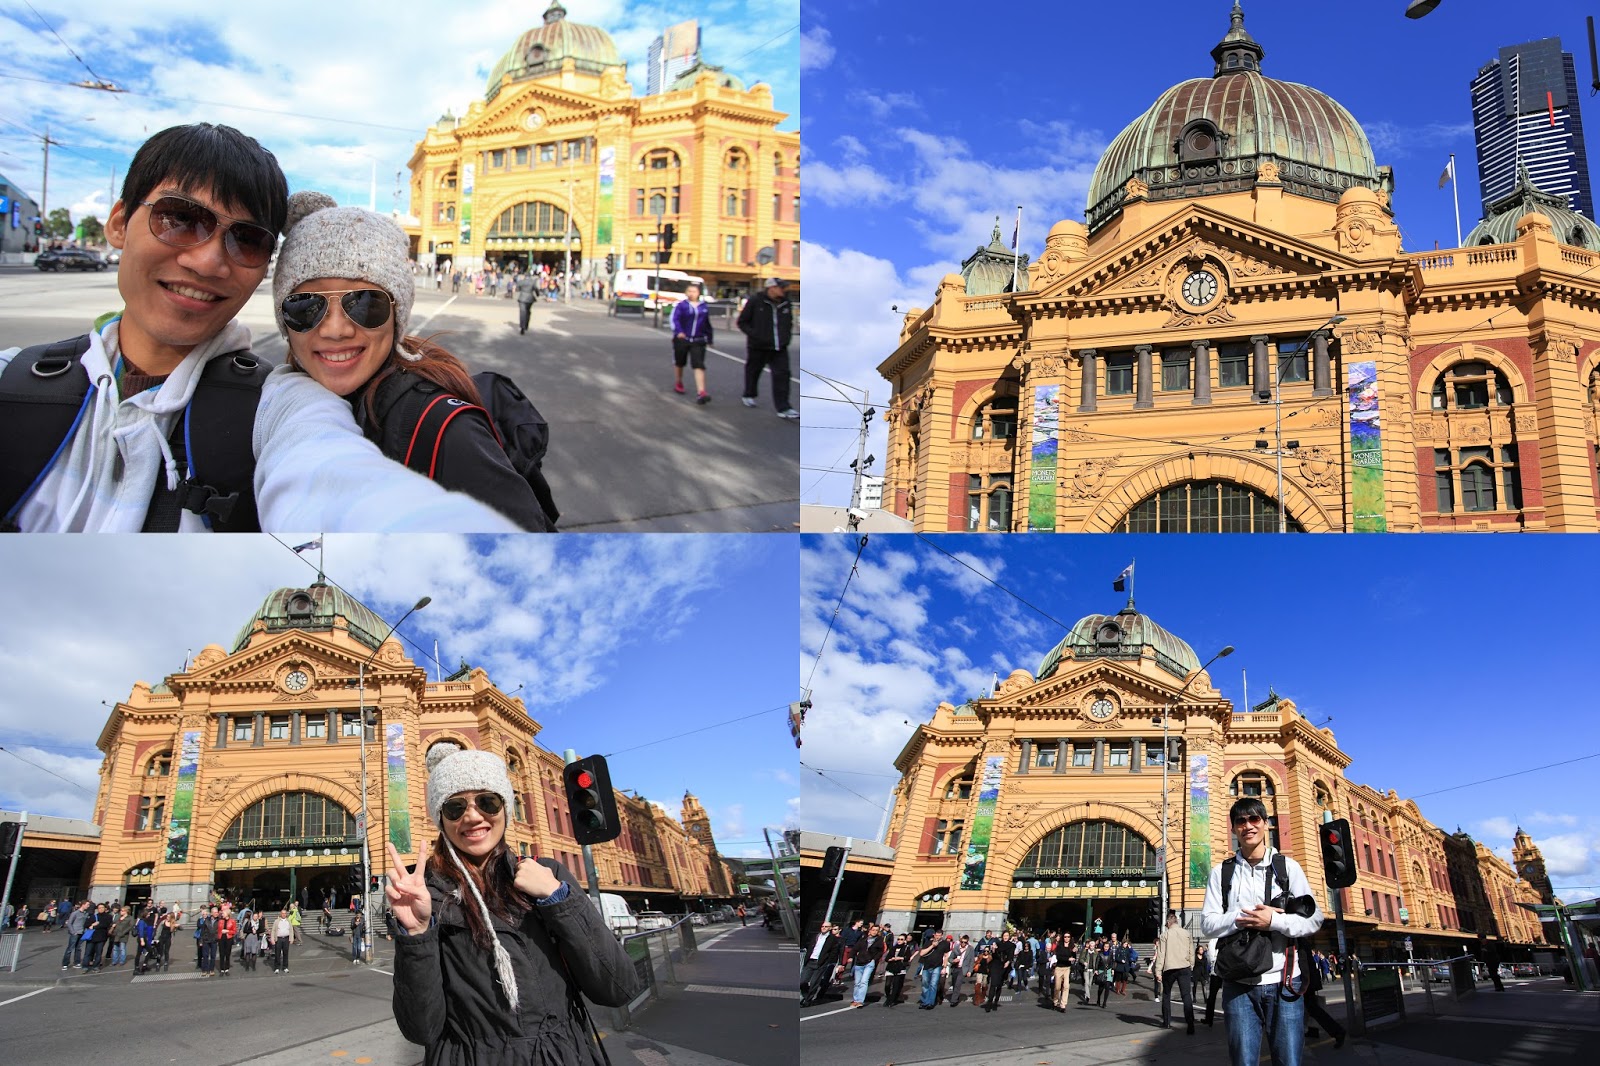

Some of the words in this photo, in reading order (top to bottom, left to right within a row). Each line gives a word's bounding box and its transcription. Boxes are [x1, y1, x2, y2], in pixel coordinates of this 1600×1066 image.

[238, 839, 272, 847] FLINDERS
[313, 836, 345, 844] STATION
[1035, 868, 1070, 876] FLINDERS
[1111, 867, 1144, 875] STATION
